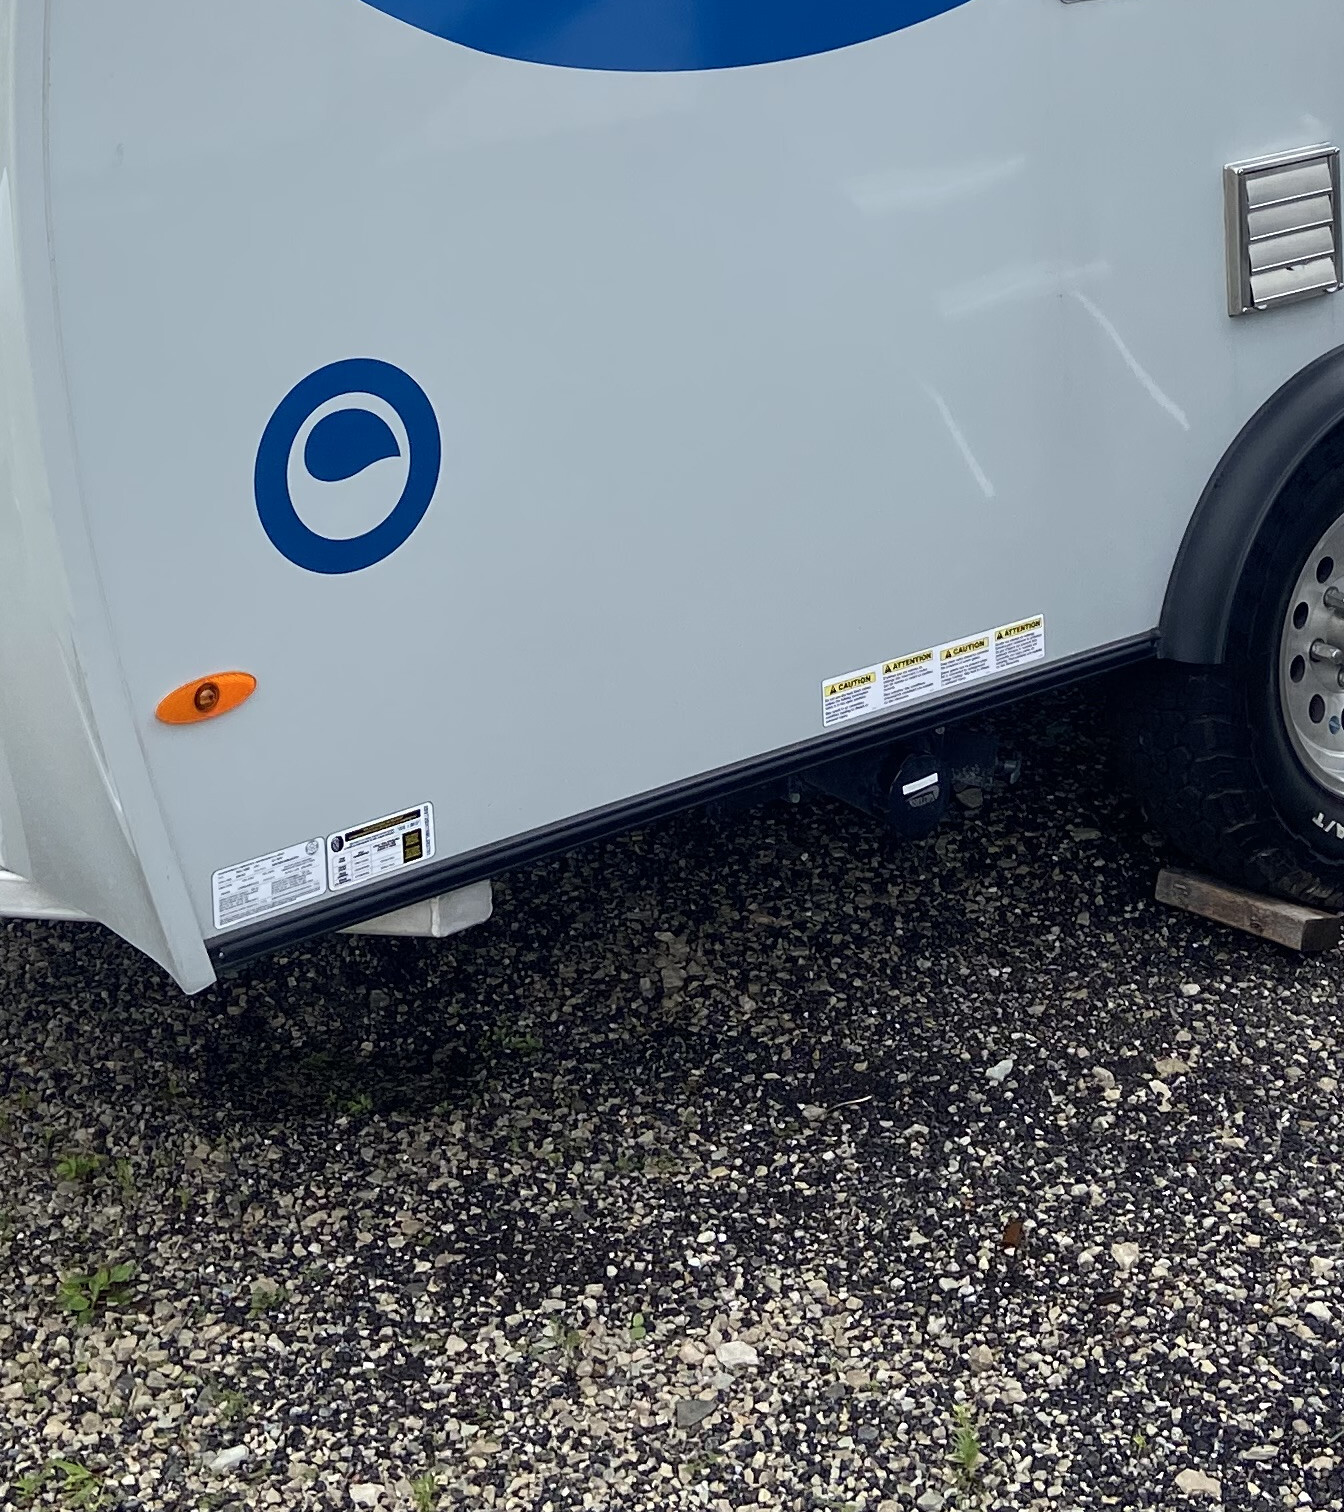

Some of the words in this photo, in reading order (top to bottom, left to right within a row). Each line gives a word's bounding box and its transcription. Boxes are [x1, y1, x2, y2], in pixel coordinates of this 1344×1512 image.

[1003, 620, 1041, 637] ATTENTION
[952, 639, 985, 655] CAUTION
[892, 652, 932, 671] ATTENTION
[838, 675, 872, 691] CAUTION
